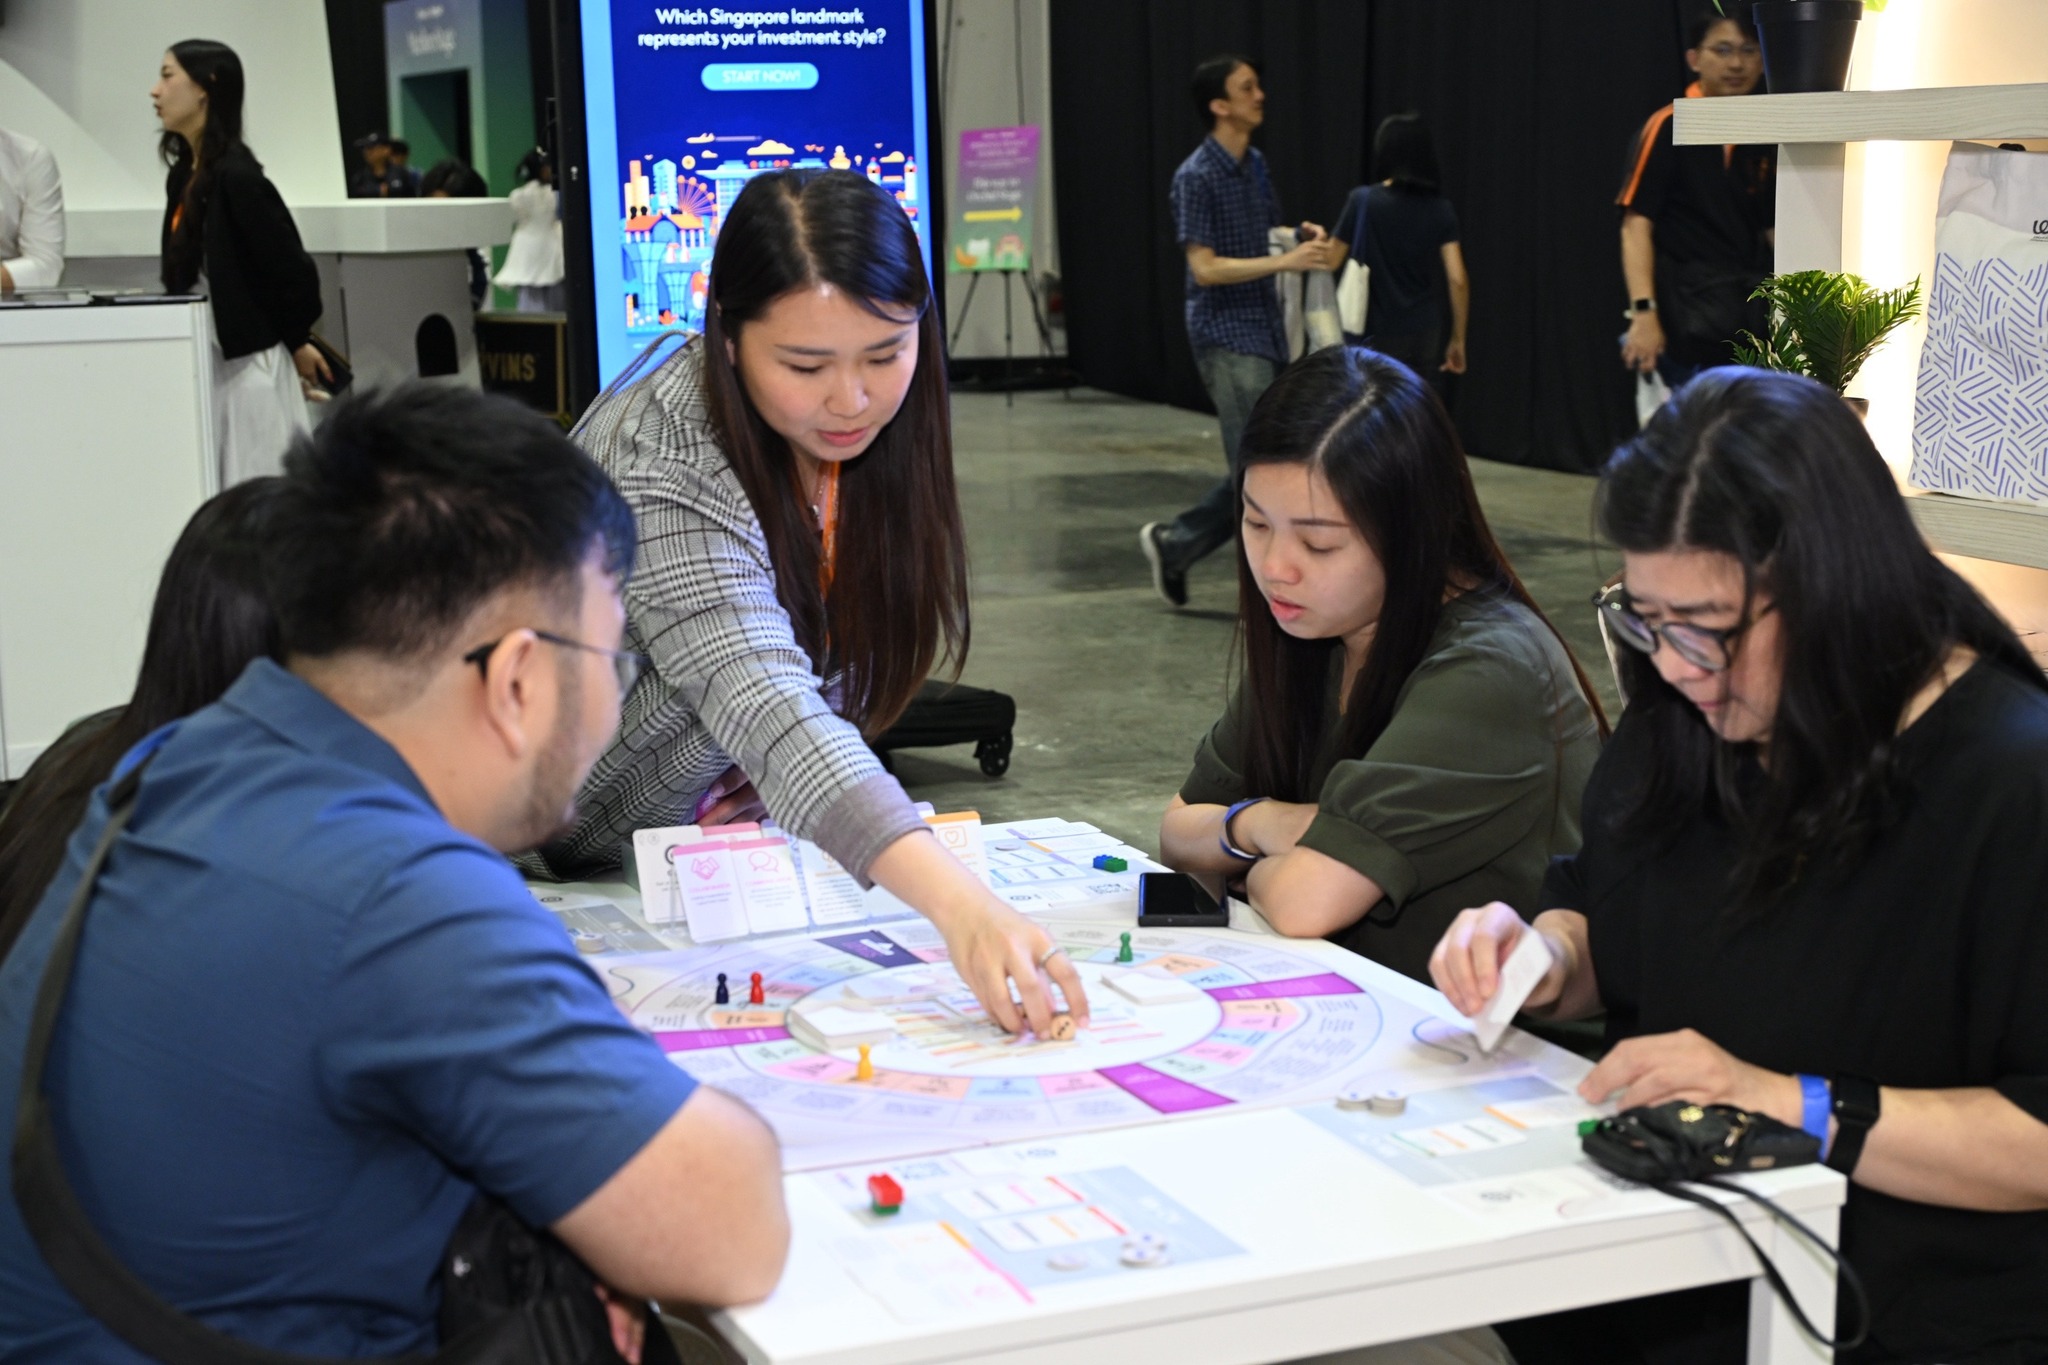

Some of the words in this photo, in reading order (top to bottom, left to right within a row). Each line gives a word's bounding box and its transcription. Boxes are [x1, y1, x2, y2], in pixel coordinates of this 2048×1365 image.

[655, 8, 708, 25] Which
[710, 8, 789, 29] Singapore
[791, 8, 864, 25] landmark
[638, 31, 719, 50] represents
[721, 33, 756, 50] your
[757, 30, 841, 46] investment
[843, 28, 886, 49] style?
[722, 69, 761, 84] START
[762, 68, 801, 83] NOW!
